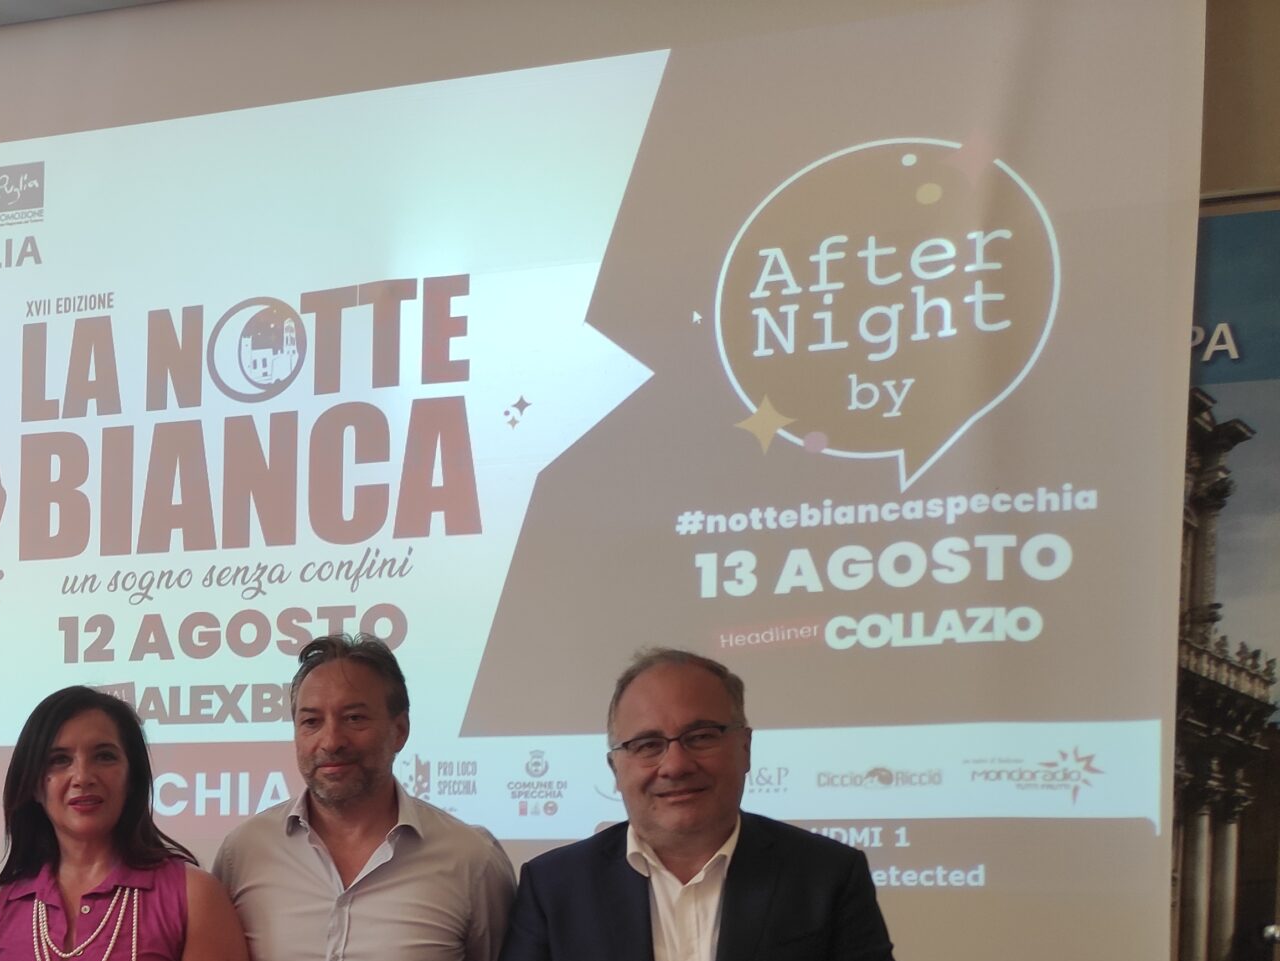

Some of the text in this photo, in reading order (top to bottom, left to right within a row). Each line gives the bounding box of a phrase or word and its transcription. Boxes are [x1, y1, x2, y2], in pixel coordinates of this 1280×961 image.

[748, 228, 1013, 299] After
[25, 291, 114, 318] XVII EDIZIONE
[751, 279, 1012, 362] Night
[21, 314, 122, 423] LA
[847, 374, 916, 418] by
[19, 395, 483, 561] BIANCA
[675, 482, 1099, 536] #nottebiancaspecchia
[61, 546, 414, 606] un sogno senza confini
[694, 532, 1074, 599] 13 AGOSTO
[57, 613, 116, 665] 12
[719, 605, 1044, 650] Headliner COLLAZIO
[437, 760, 478, 777] PRO LOCO
[437, 780, 478, 796] SPECCHIA
[506, 780, 568, 791] COMUNE DI
[816, 771, 864, 789] Ciccio
[510, 790, 564, 800] SPECCHIA
[811, 826, 911, 848] DMI 1
[870, 863, 986, 888] etected
